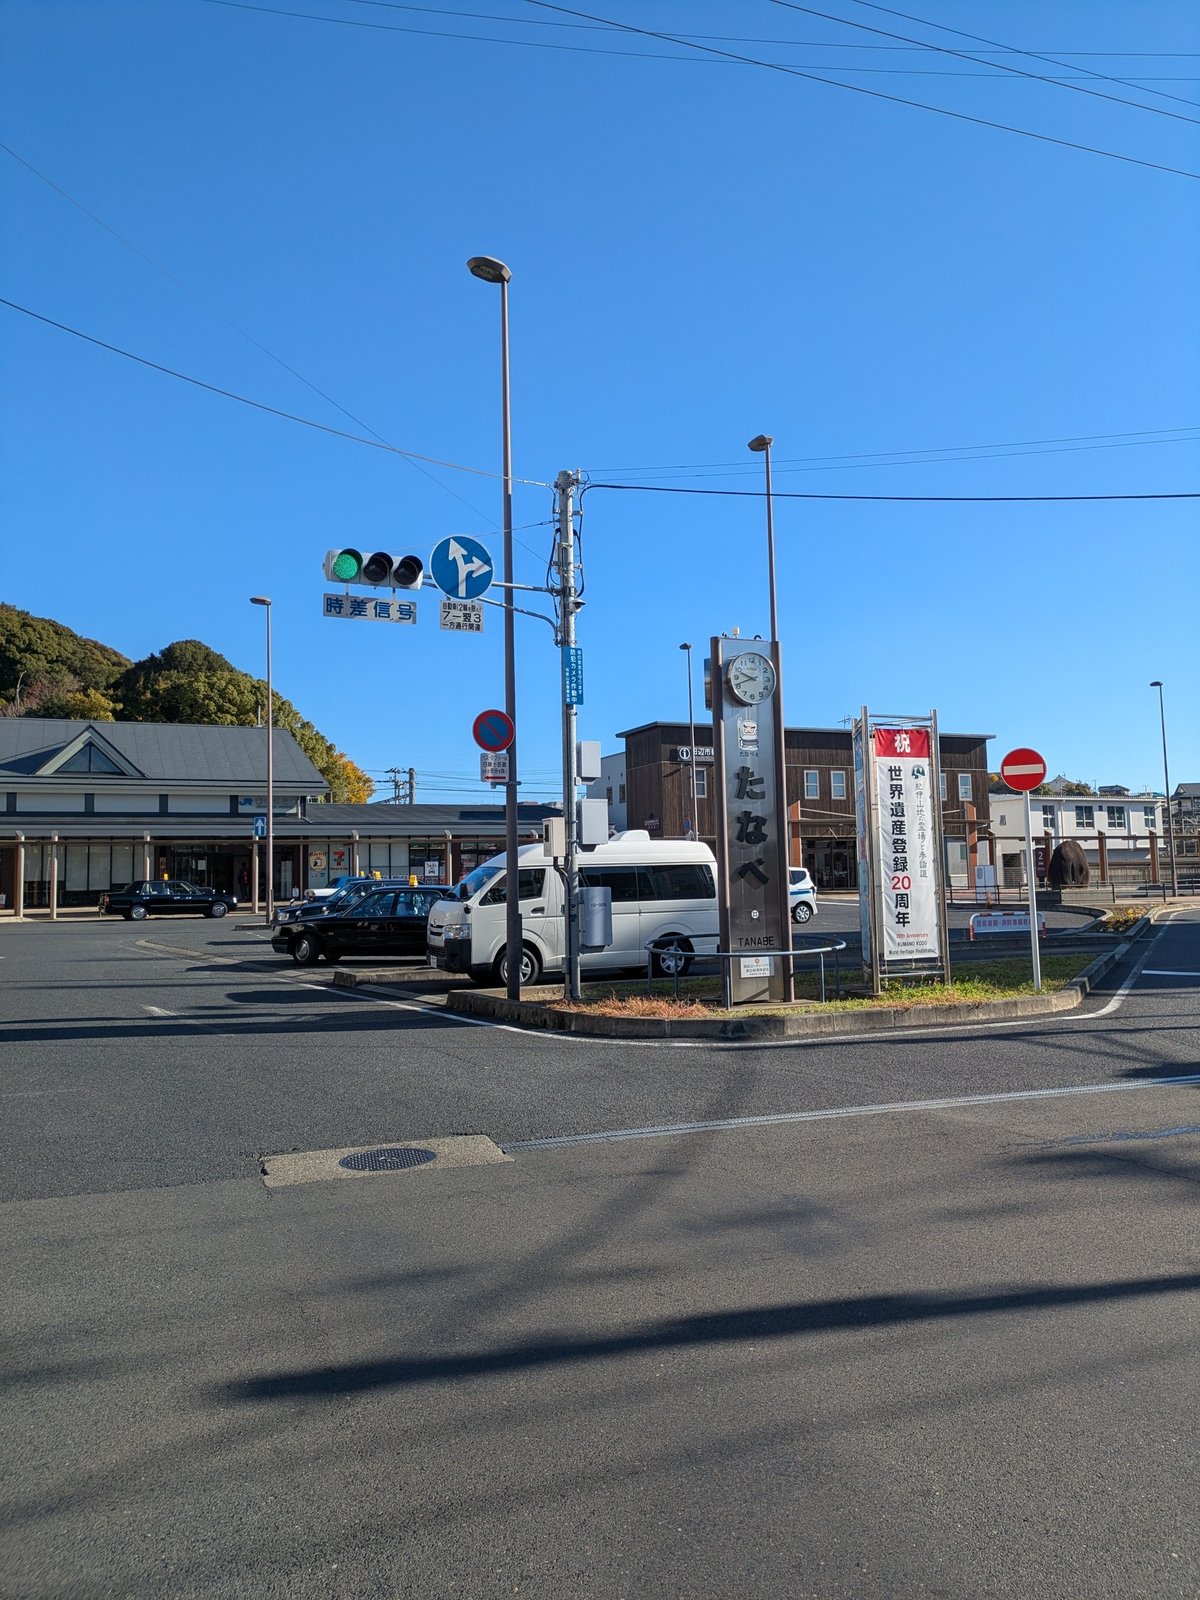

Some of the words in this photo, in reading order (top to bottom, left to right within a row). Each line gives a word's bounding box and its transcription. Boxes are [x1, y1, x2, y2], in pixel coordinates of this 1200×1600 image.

[326, 597, 414, 620] 時差信号
[894, 733, 911, 753] 祝
[735, 765, 769, 885] たなべ
[888, 765, 912, 928] 世界遺産登録20周年
[1038, 851, 1044, 860] 2
[738, 936, 775, 947] TANABE
